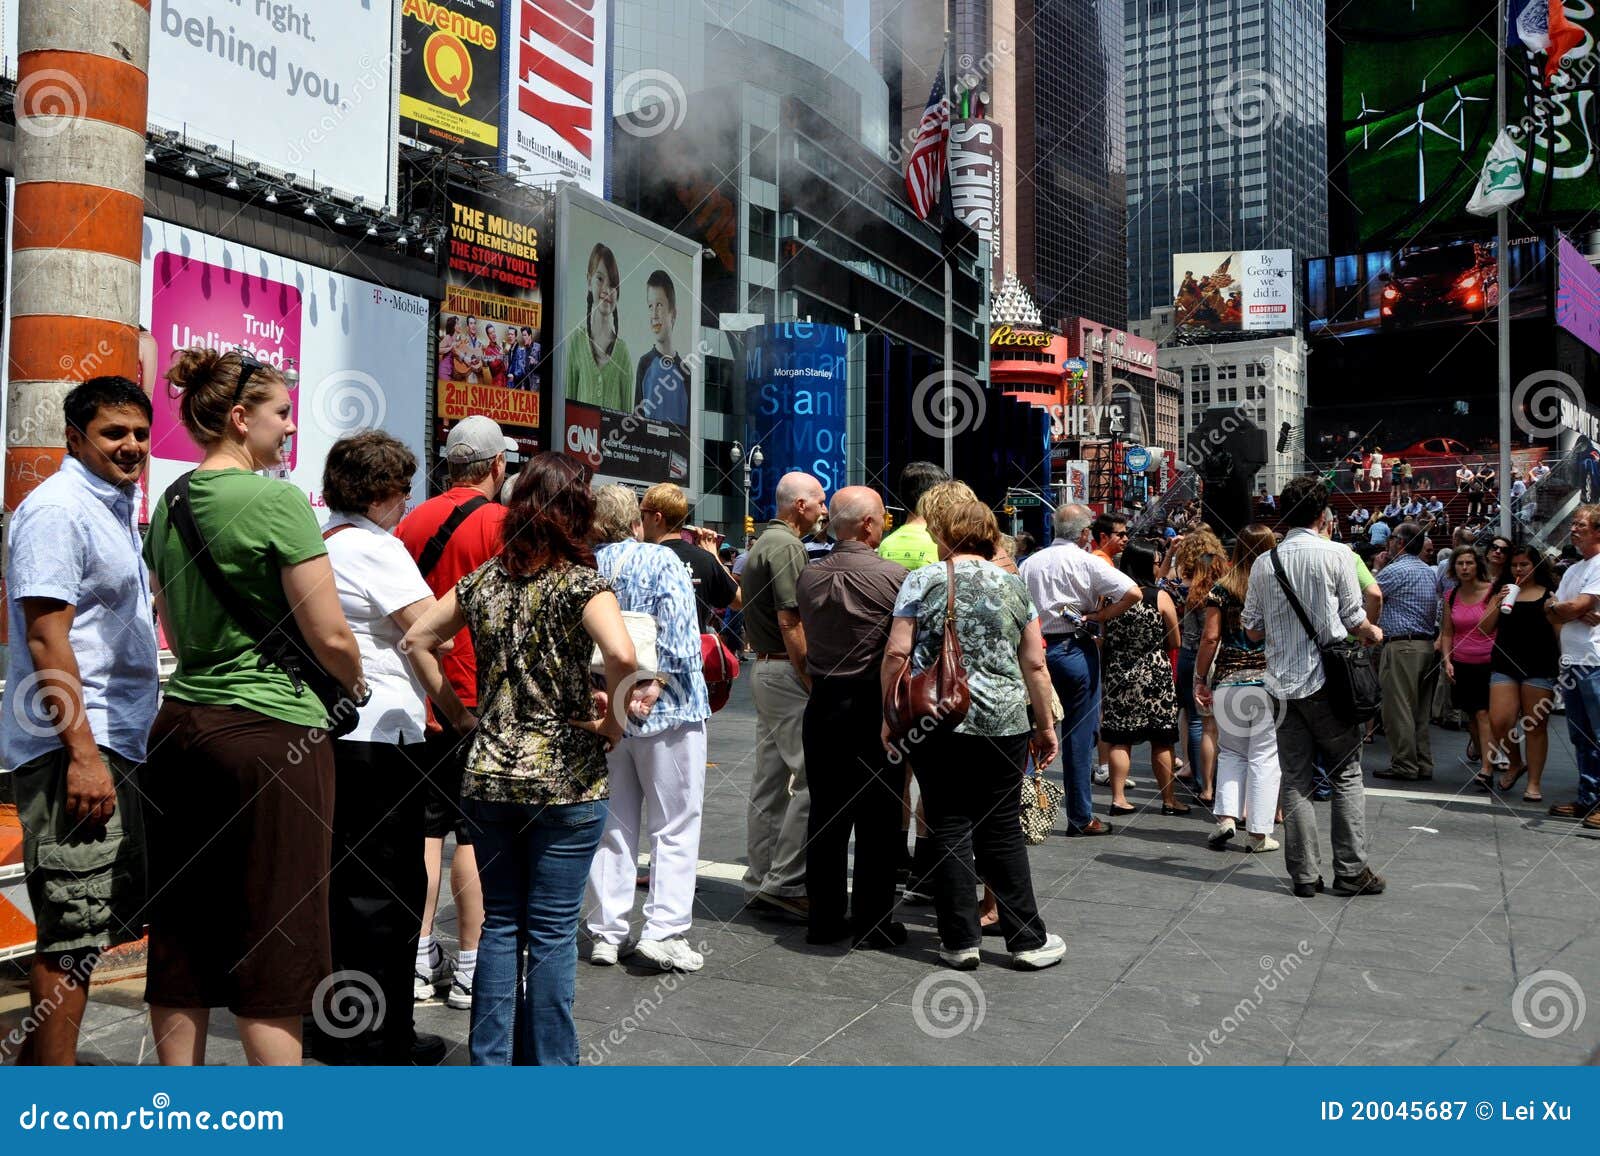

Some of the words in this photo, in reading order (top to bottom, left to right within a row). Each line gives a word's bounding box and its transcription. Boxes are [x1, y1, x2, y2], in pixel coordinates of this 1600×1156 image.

[403, 0, 497, 50] Avenue
[160, 7, 277, 80] behind
[287, 62, 347, 111] you.
[423, 30, 474, 107] Q
[451, 202, 484, 230] THE
[487, 213, 538, 245] MUSIC
[451, 223, 475, 243] YOU
[476, 230, 539, 262] REMEMBER.
[1507, 236, 1539, 246] YUNDAI
[449, 258, 490, 279] NEVER
[450, 240, 470, 258] THE
[470, 245, 504, 266] STORY
[505, 251, 537, 277] YOU'LL
[1261, 254, 1274, 266] By
[1253, 287, 1270, 298] did
[1272, 288, 1281, 298] it.
[1260, 279, 1275, 287] we
[242, 314, 285, 344] Truly
[990, 324, 1054, 348] Reese's
[774, 368, 804, 378] Morgan
[805, 368, 833, 380] Stanley
[445, 383, 468, 406] 2nd
[470, 388, 509, 411] SMASH
[512, 395, 538, 414] YEAR
[446, 405, 465, 417] ON
[567, 424, 598, 454] CNN
